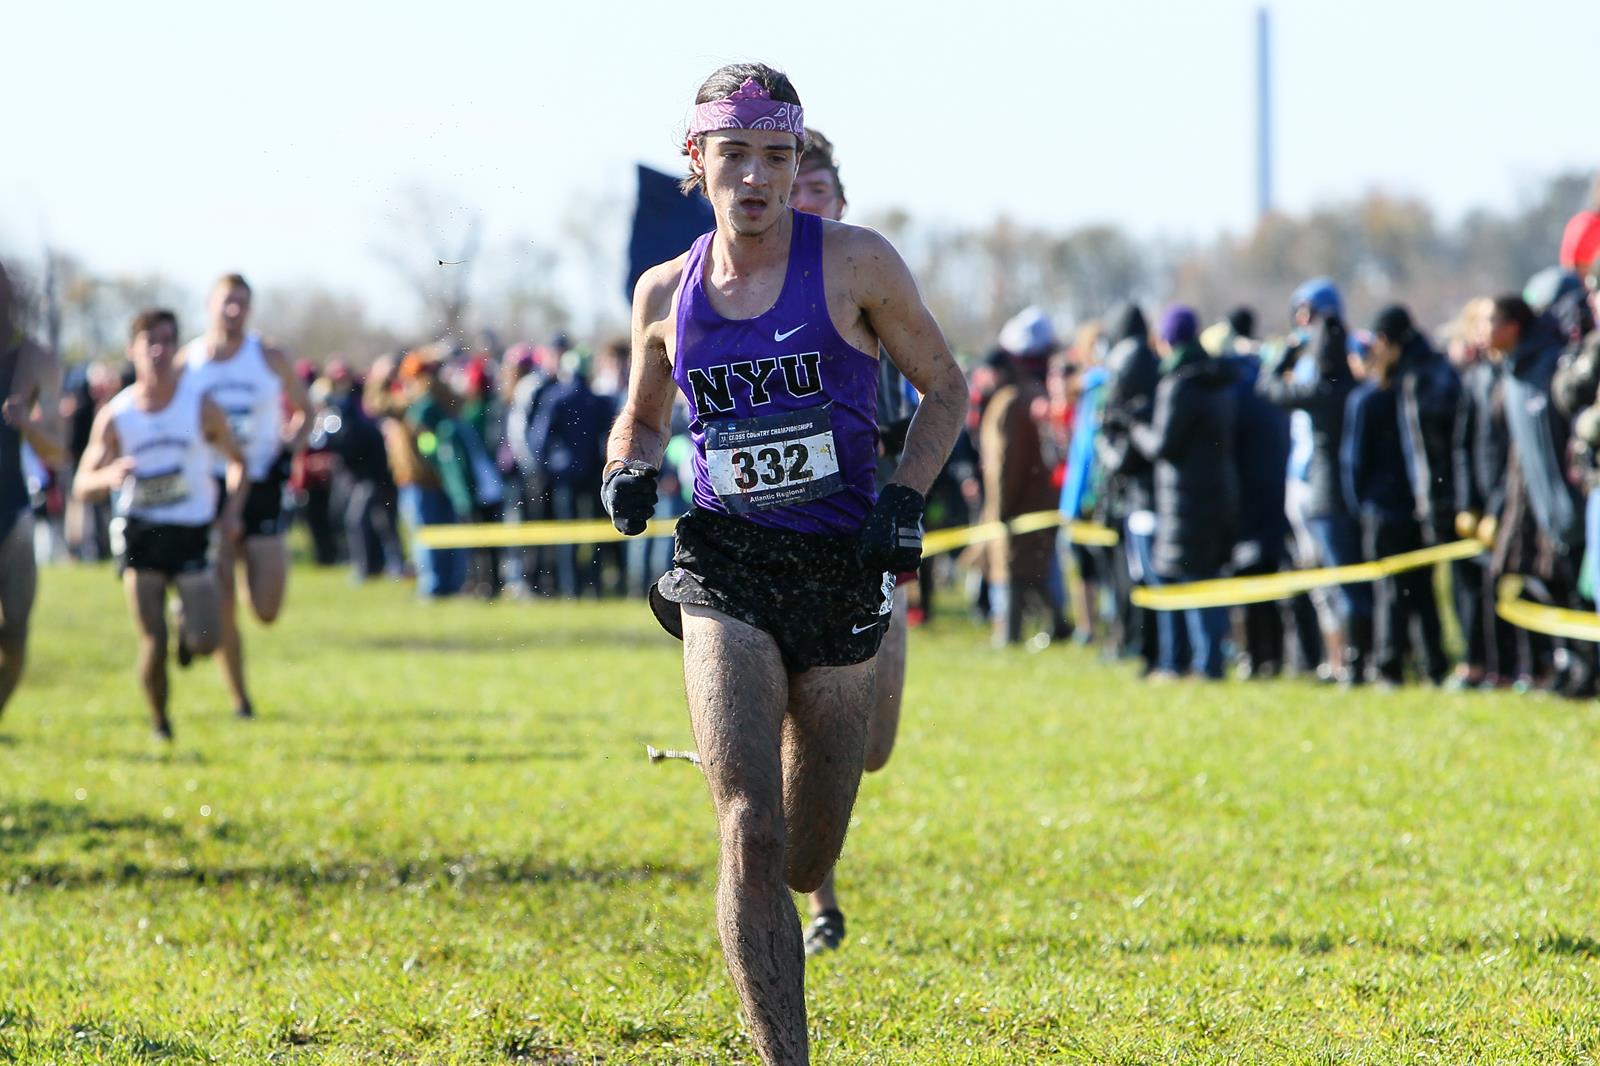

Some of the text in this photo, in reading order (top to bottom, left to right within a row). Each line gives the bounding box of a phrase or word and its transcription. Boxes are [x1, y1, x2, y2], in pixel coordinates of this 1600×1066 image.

[687, 351, 823, 416] NYU
[728, 433, 746, 441] CROSS
[746, 429, 770, 439] COUNTRY
[770, 422, 814, 436] CHAMPIONSHIPS
[731, 443, 814, 490] 332
[750, 493, 776, 503] Atlantic
[776, 487, 807, 499] Regional
